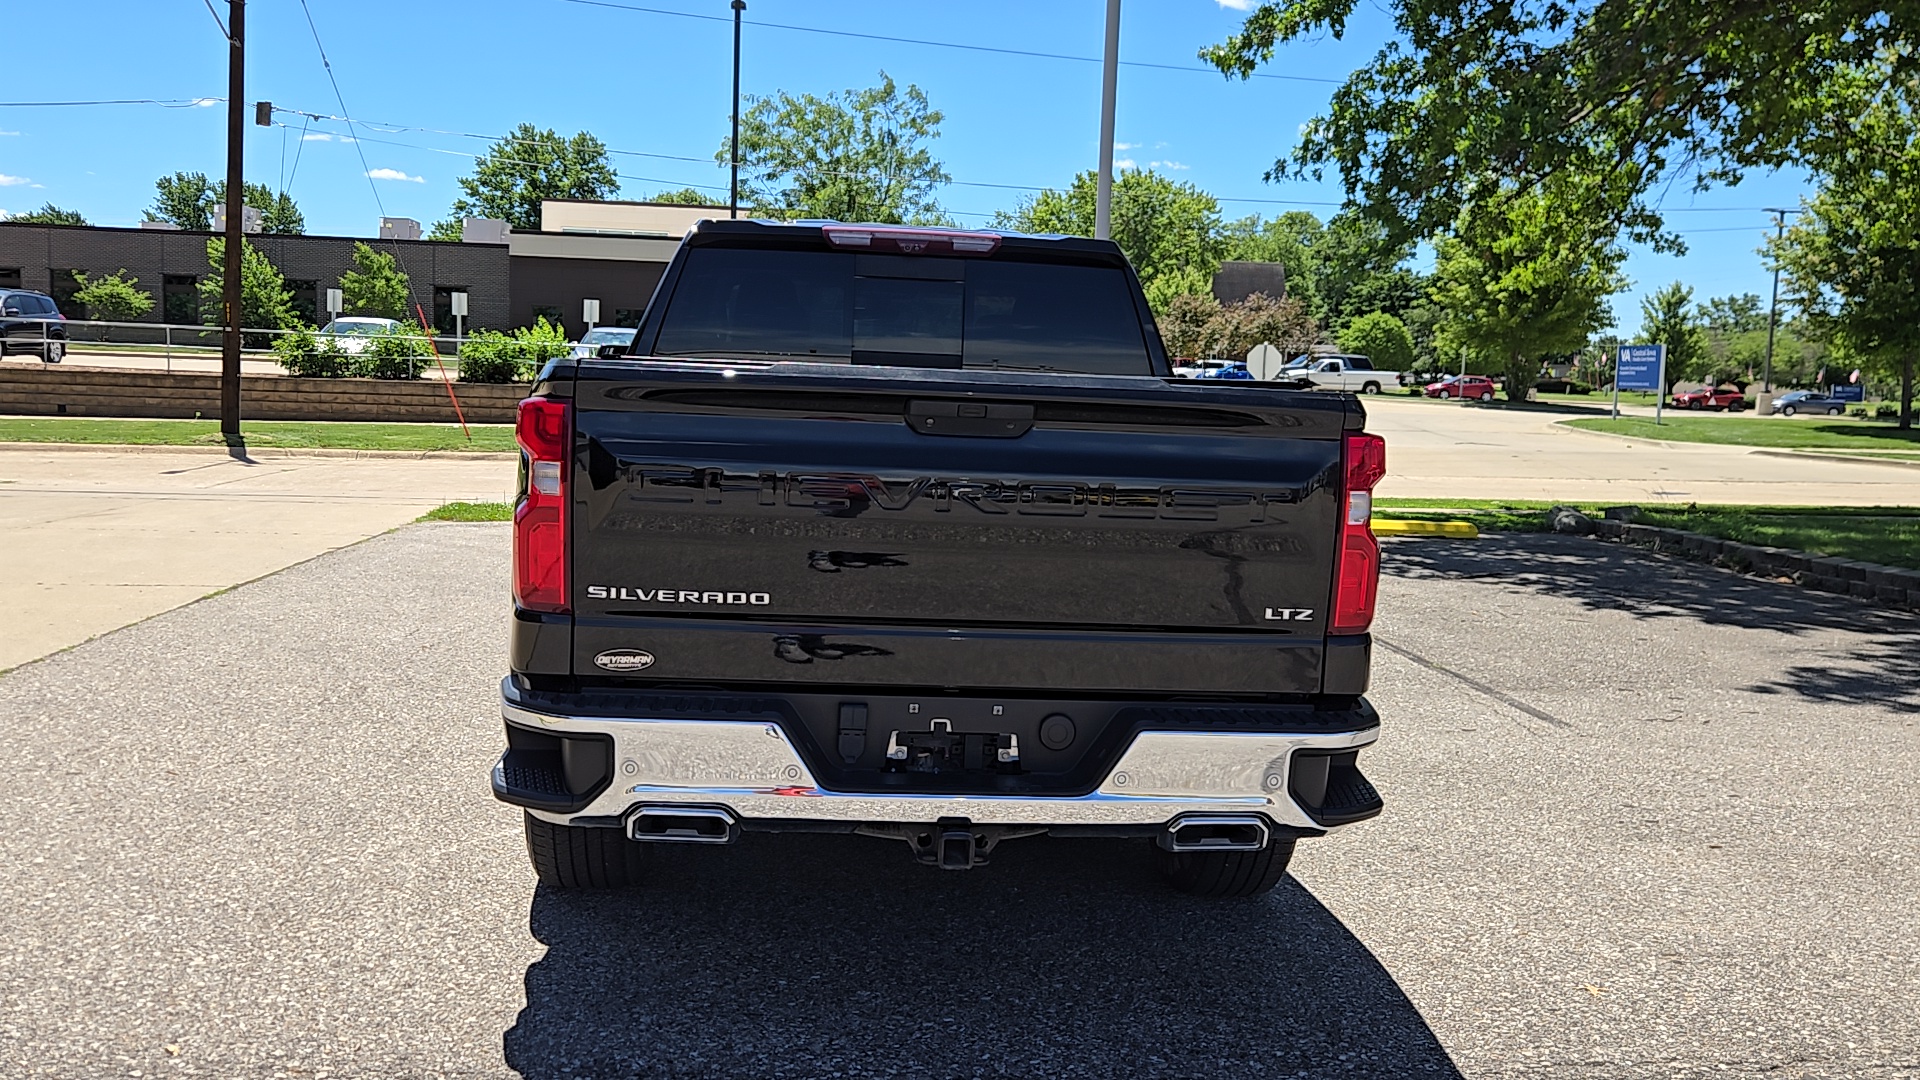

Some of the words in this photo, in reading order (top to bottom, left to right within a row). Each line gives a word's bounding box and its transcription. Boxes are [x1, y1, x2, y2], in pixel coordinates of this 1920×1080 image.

[1621, 348, 1631, 362] VA
[628, 464, 1299, 523] CHEVROLET
[587, 585, 771, 605] SILVERADO
[1264, 607, 1314, 621] LTZ
